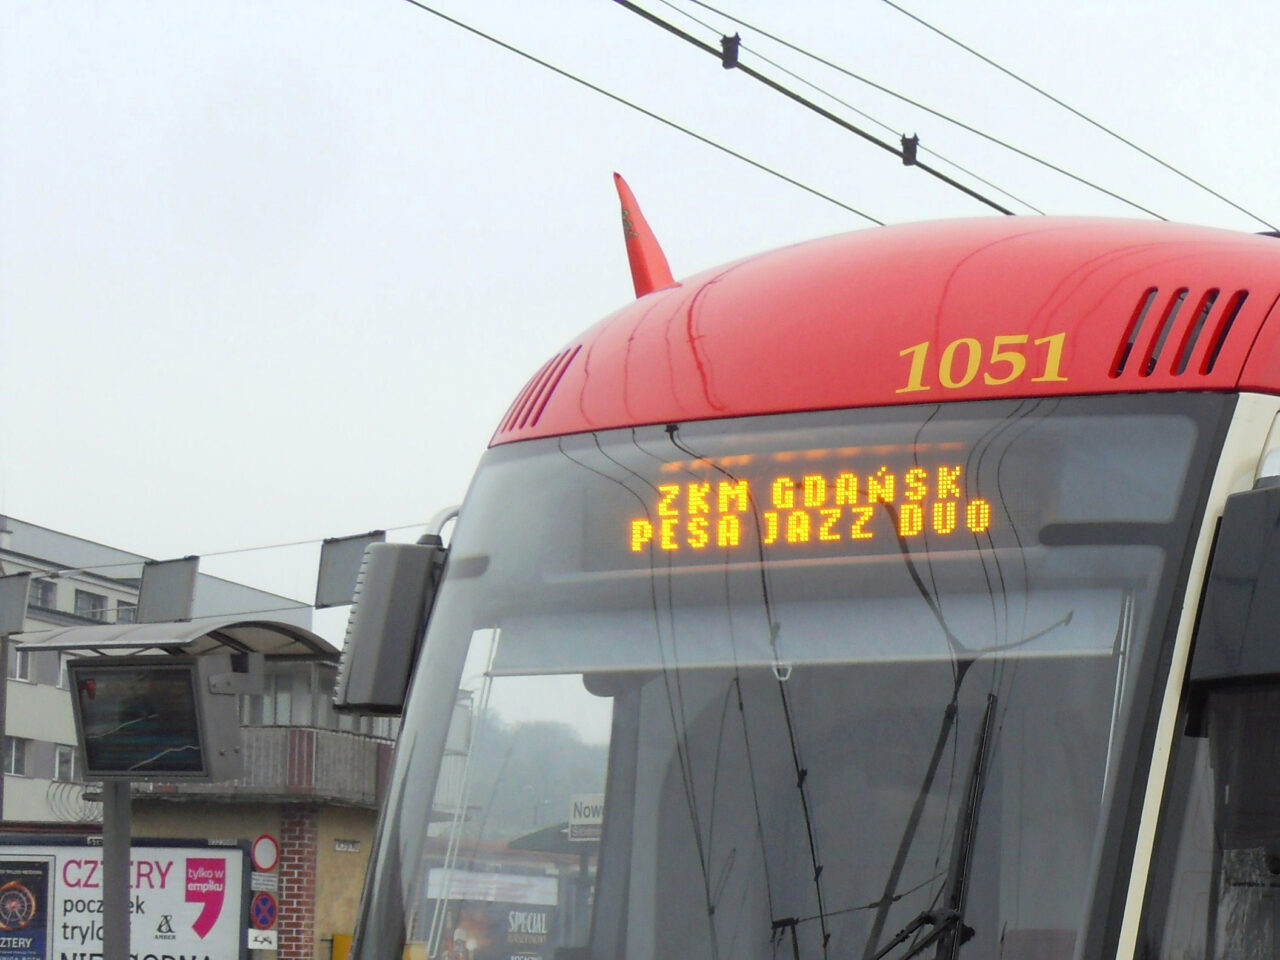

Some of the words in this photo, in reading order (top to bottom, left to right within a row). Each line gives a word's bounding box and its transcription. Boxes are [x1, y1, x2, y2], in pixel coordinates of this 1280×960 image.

[896, 332, 1069, 394] 1051
[657, 480, 748, 517] ZKM
[772, 465, 962, 509] GDAŃSK
[631, 515, 740, 552] PESA
[764, 506, 873, 544] JAZZ
[900, 499, 990, 536] DUO
[63, 859, 173, 890] CZRY
[187, 879, 223, 893] empiku
[188, 867, 213, 880] tylko
[214, 869, 224, 878] w
[63, 895, 145, 917] poczek
